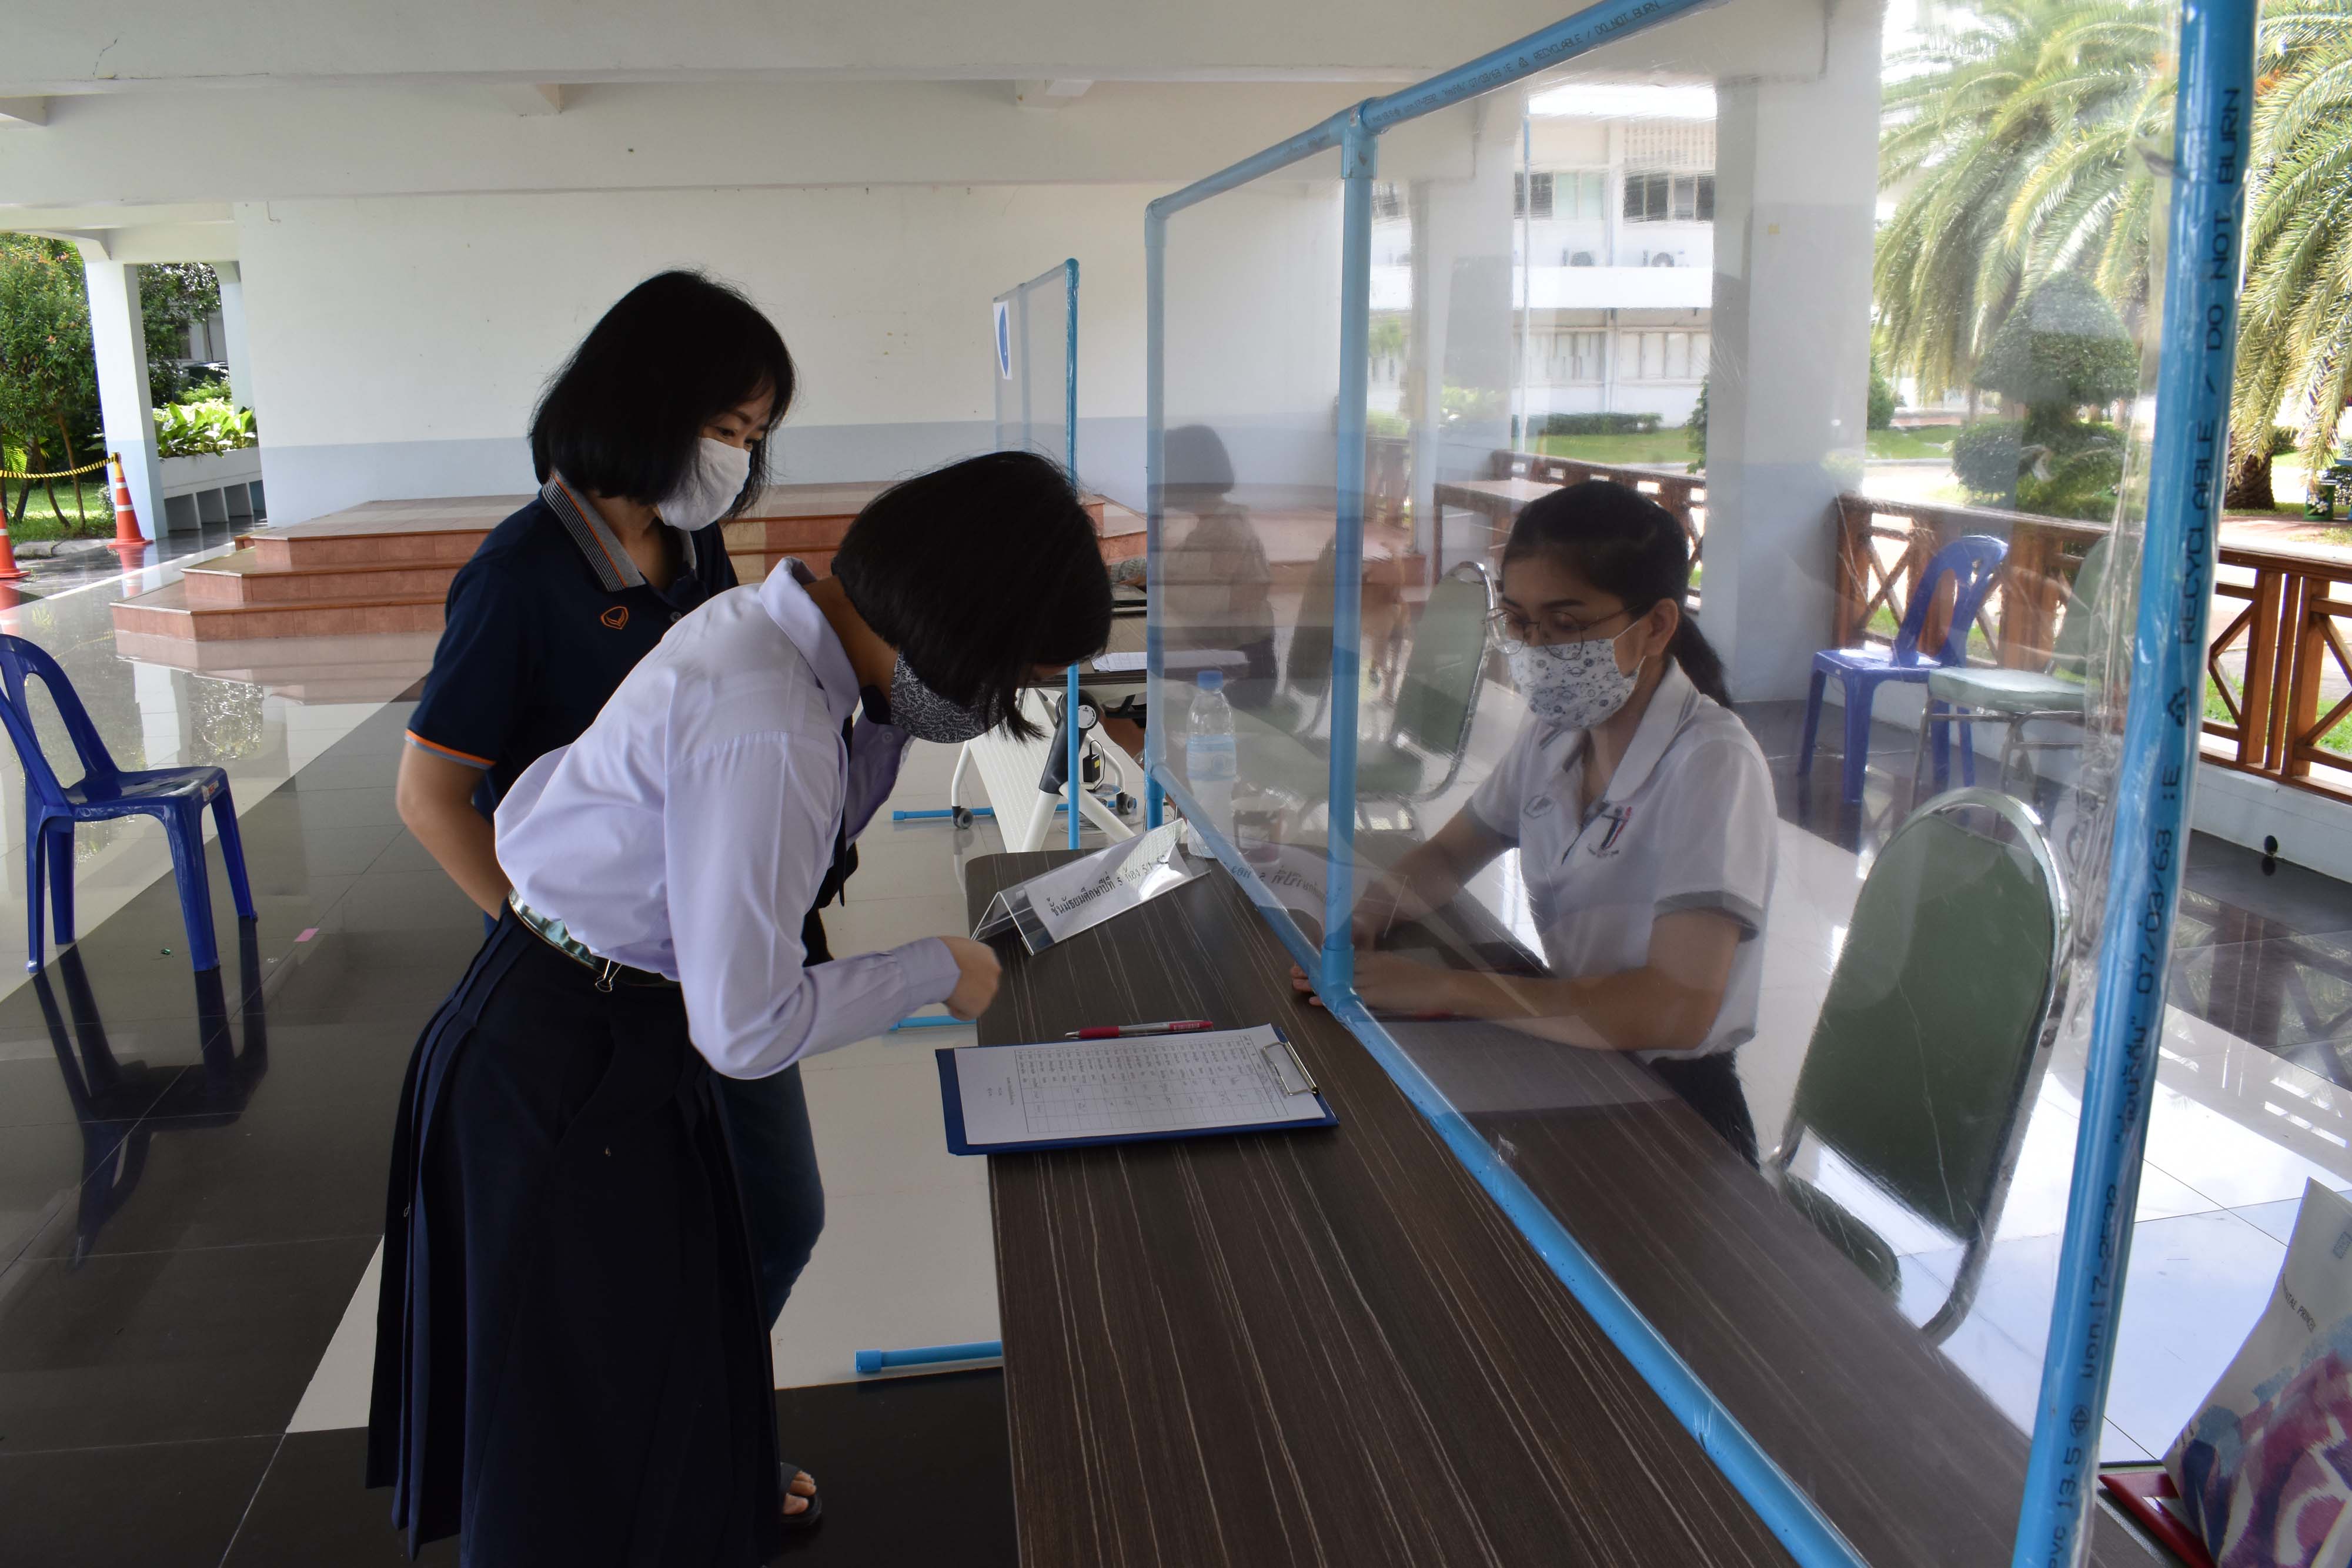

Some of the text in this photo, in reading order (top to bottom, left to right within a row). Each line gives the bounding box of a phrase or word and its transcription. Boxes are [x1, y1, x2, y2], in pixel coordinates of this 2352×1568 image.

[1533, 33, 1583, 62] RECYCLABLE
[1594, 22, 1609, 35] DO
[1610, 13, 1629, 28] NOT
[1632, 1, 1661, 19] BURN
[2217, 88, 2240, 185] BURN
[2210, 210, 2232, 280] NOT
[2207, 304, 2224, 351] DO
[2177, 419, 2215, 644] RECYCLABLE
[1046, 871, 1115, 917] ชั้นมัธยมศึกษาปีที่
[1117, 877, 1123, 886] 5
[1124, 865, 1141, 882] ห้อง
[2136, 828, 2173, 994] 07/03/63
[2057, 1446, 2082, 1508] 13.5
[2047, 1524, 2066, 1568] PVC
